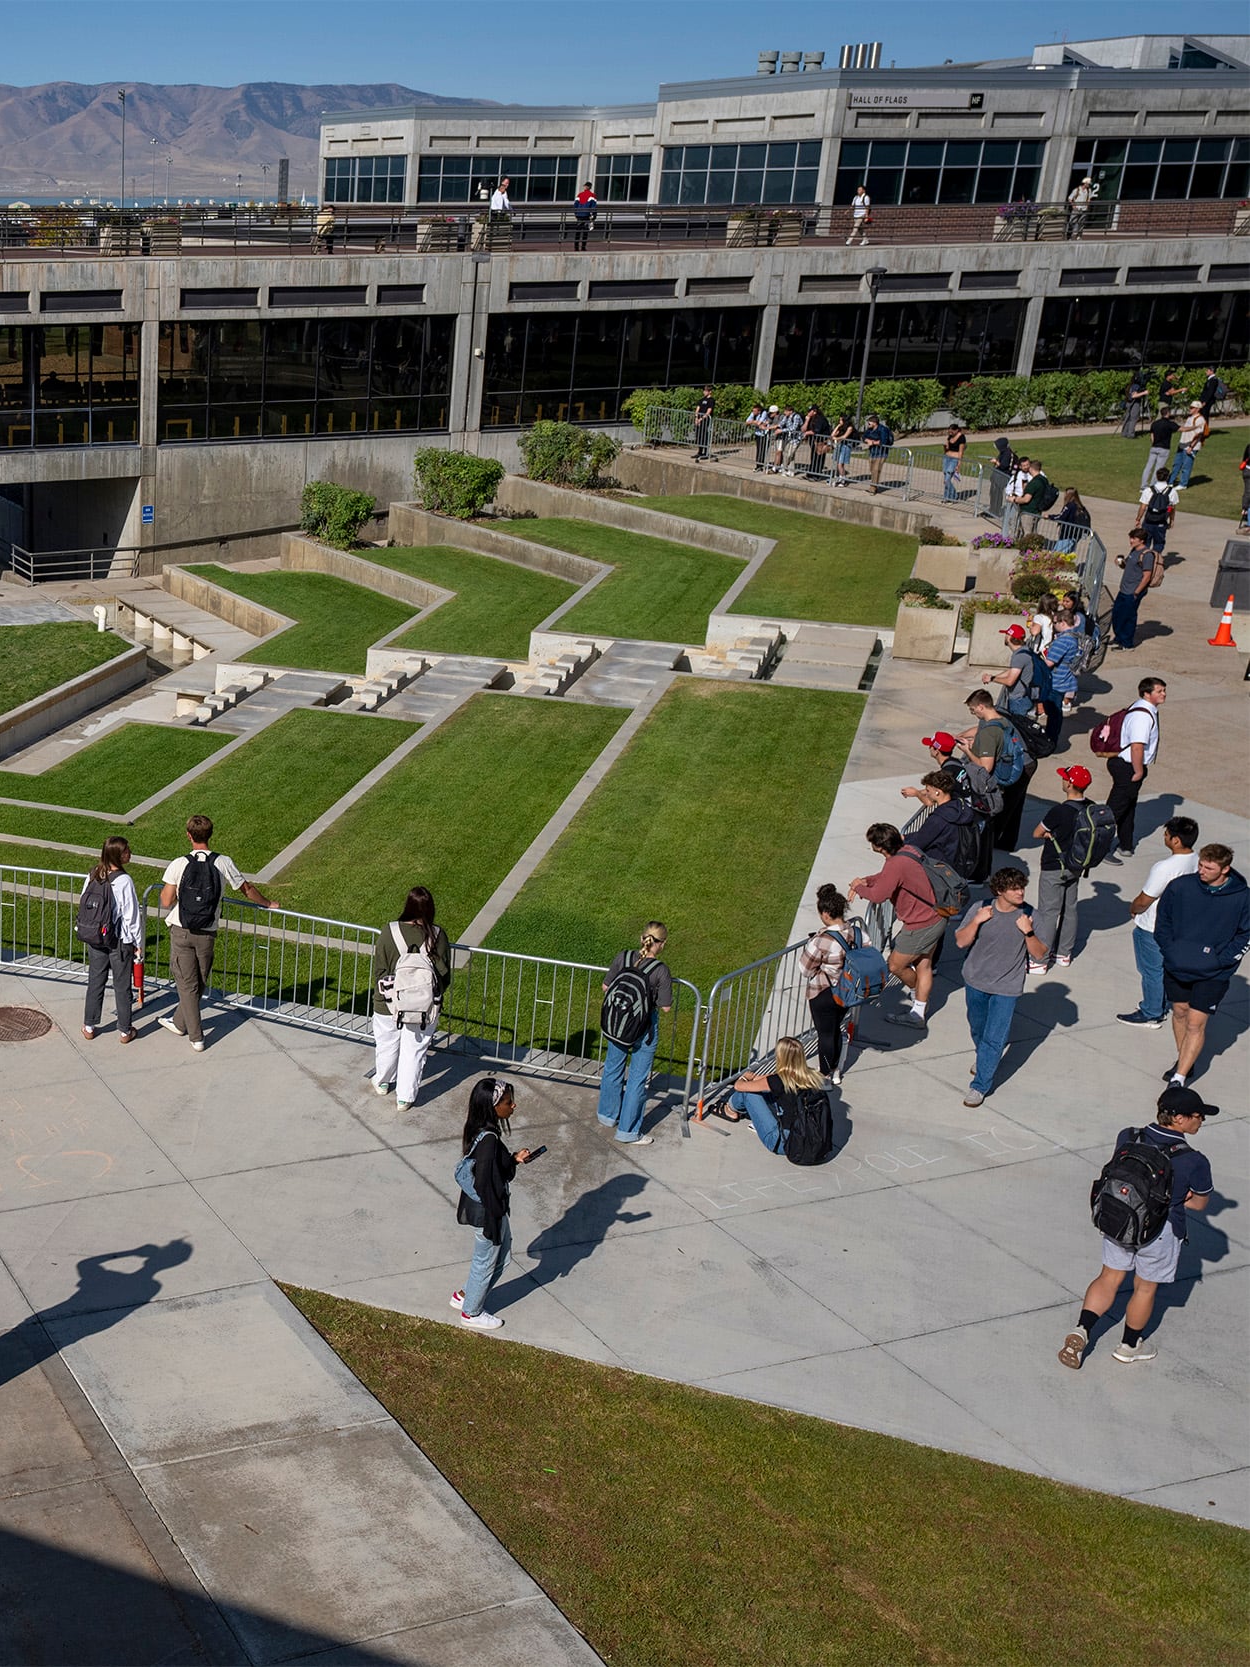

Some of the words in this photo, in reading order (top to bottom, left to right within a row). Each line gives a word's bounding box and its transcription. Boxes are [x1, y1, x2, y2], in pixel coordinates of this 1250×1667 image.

[853, 96, 871, 104] HALL
[874, 96, 883, 104] OF
[884, 96, 908, 104] FLAGS
